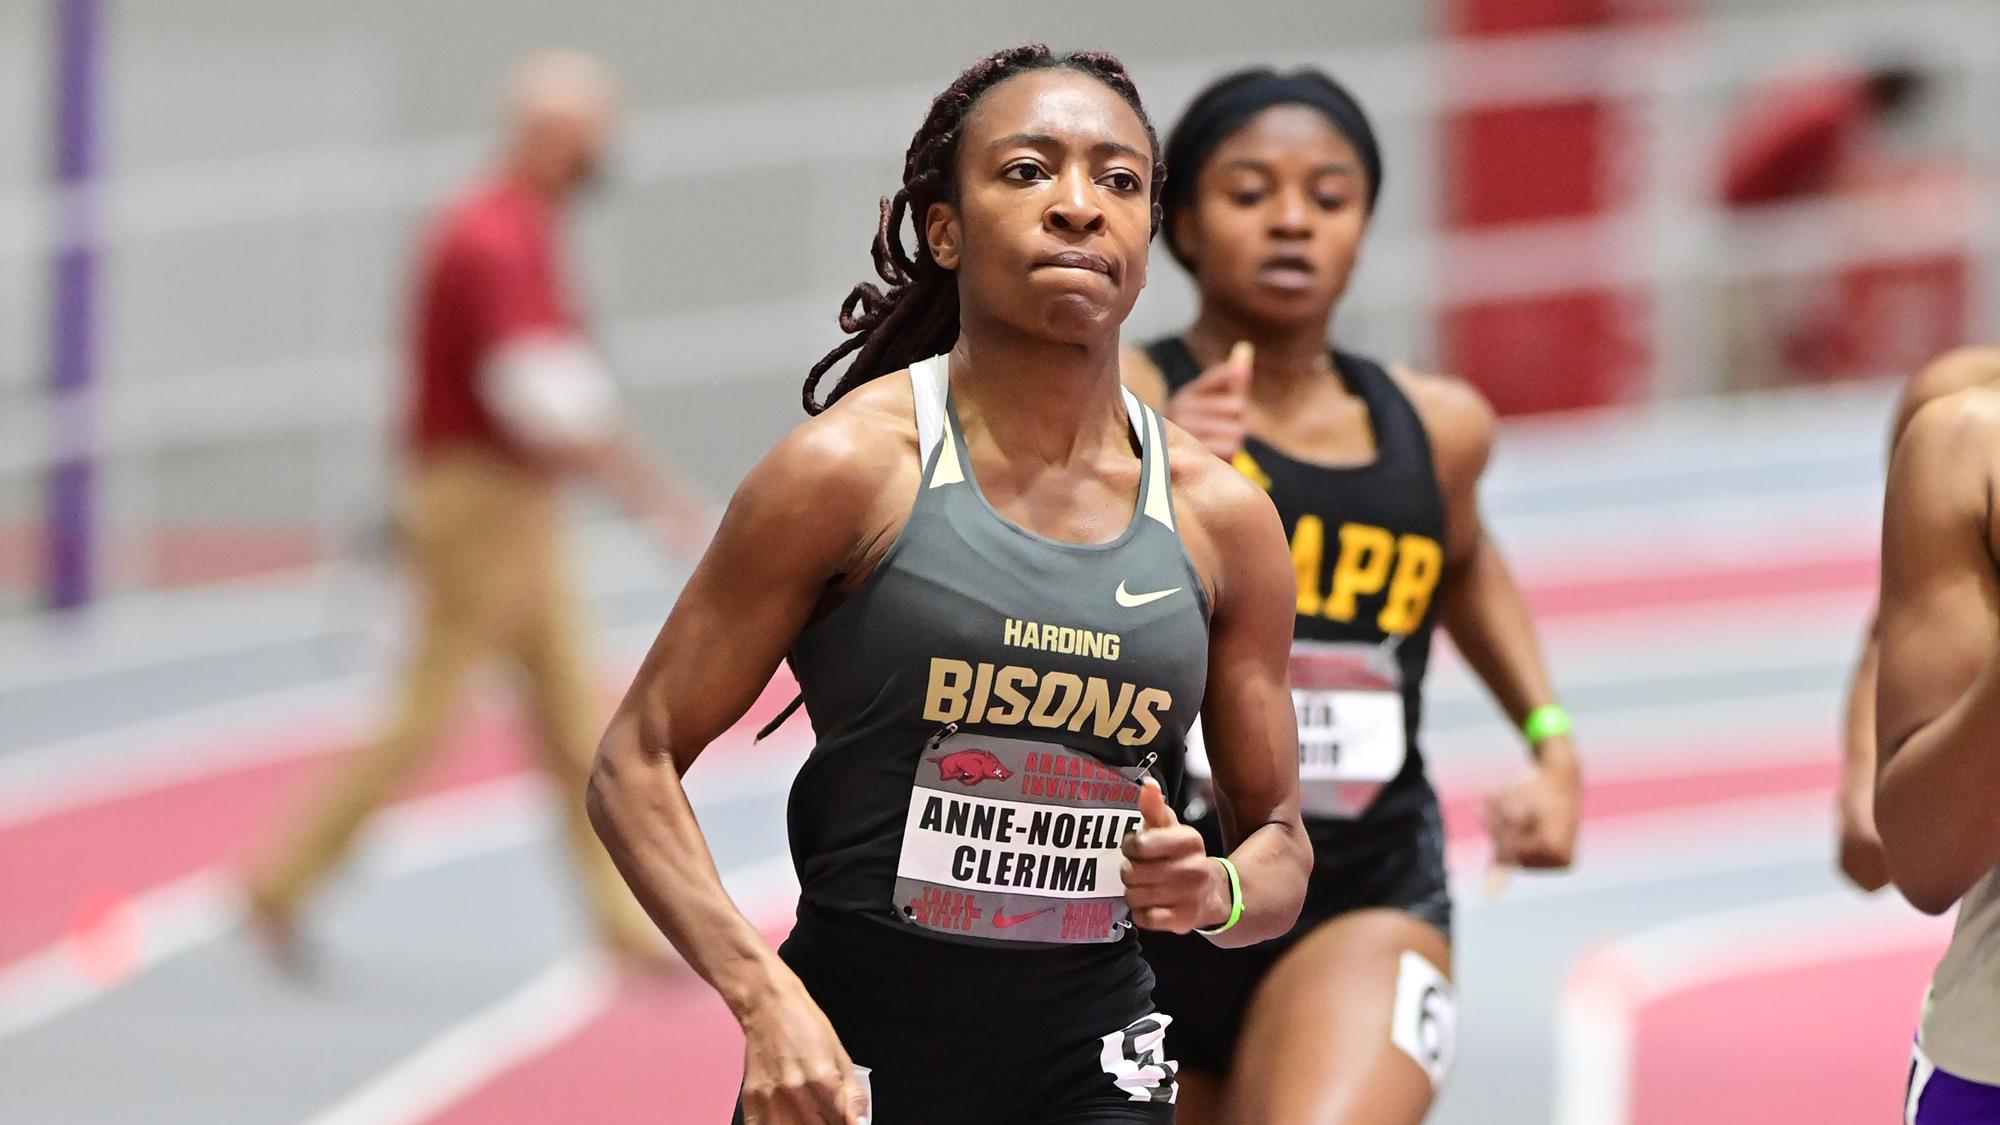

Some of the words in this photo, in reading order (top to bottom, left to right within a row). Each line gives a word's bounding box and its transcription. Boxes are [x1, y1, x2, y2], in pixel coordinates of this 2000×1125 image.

[1003, 618, 1121, 661] HARDING
[922, 657, 1172, 746] BISONS
[1022, 774, 1140, 804] INVITATION
[1024, 752, 1130, 784] ARKANS
[919, 796, 1141, 850] ANNE-NOELLE
[951, 845, 1098, 892] CLERIMA
